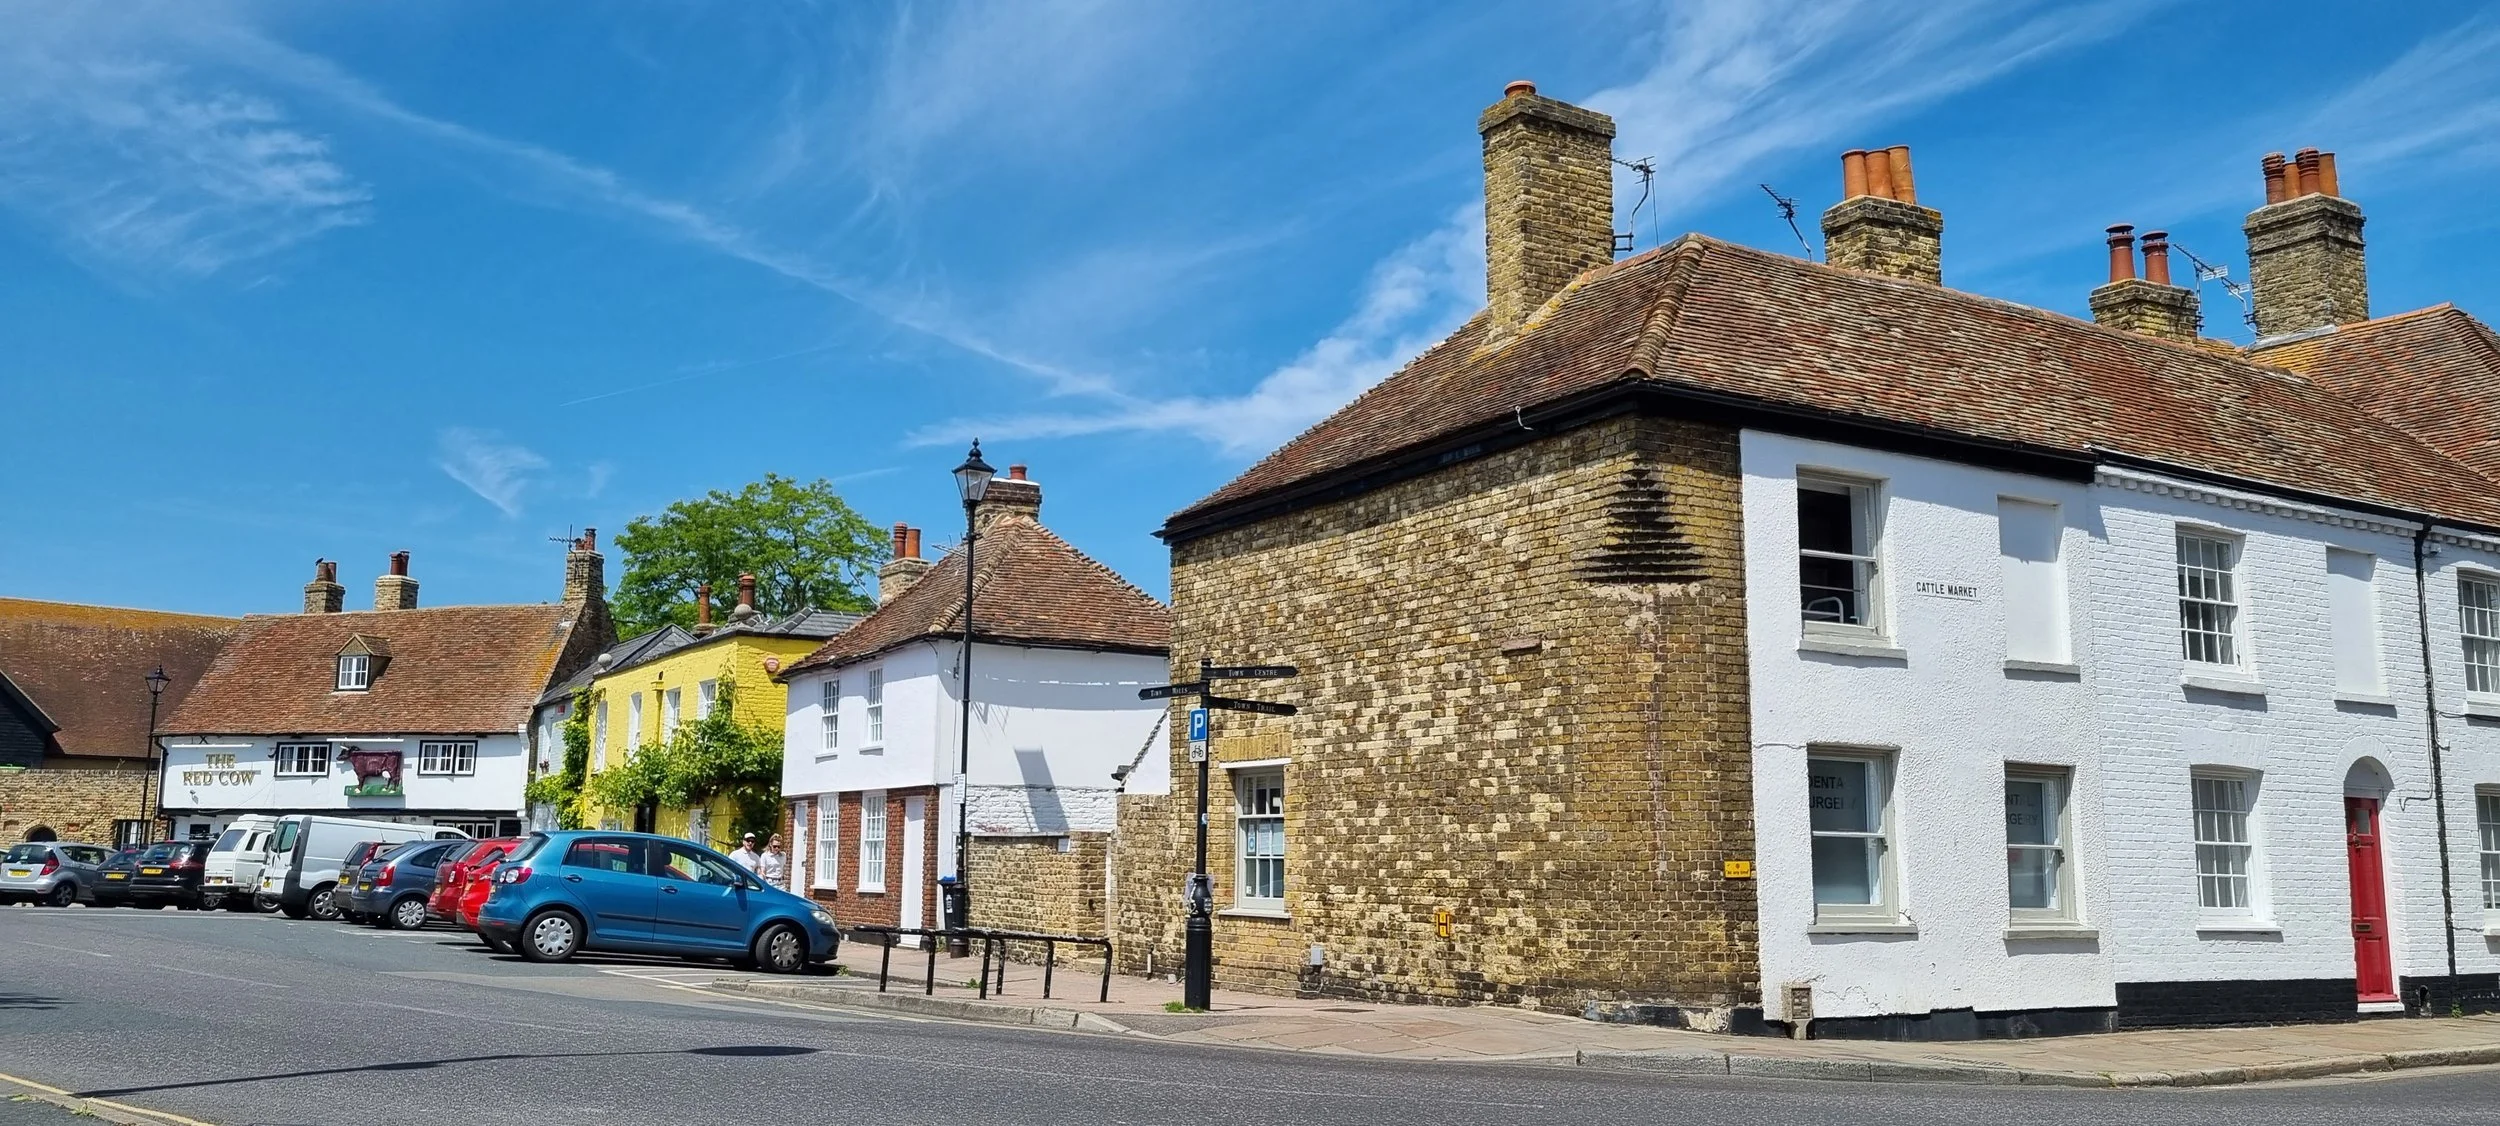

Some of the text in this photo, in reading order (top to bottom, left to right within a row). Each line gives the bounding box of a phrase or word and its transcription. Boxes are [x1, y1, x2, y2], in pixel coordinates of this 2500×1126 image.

[1916, 581, 1978, 598] CATTLE MARKET
[1194, 713, 1204, 737] P
[206, 753, 235, 769] THE
[183, 770, 256, 786] RED COW
[1808, 775, 1845, 789] DENTA
